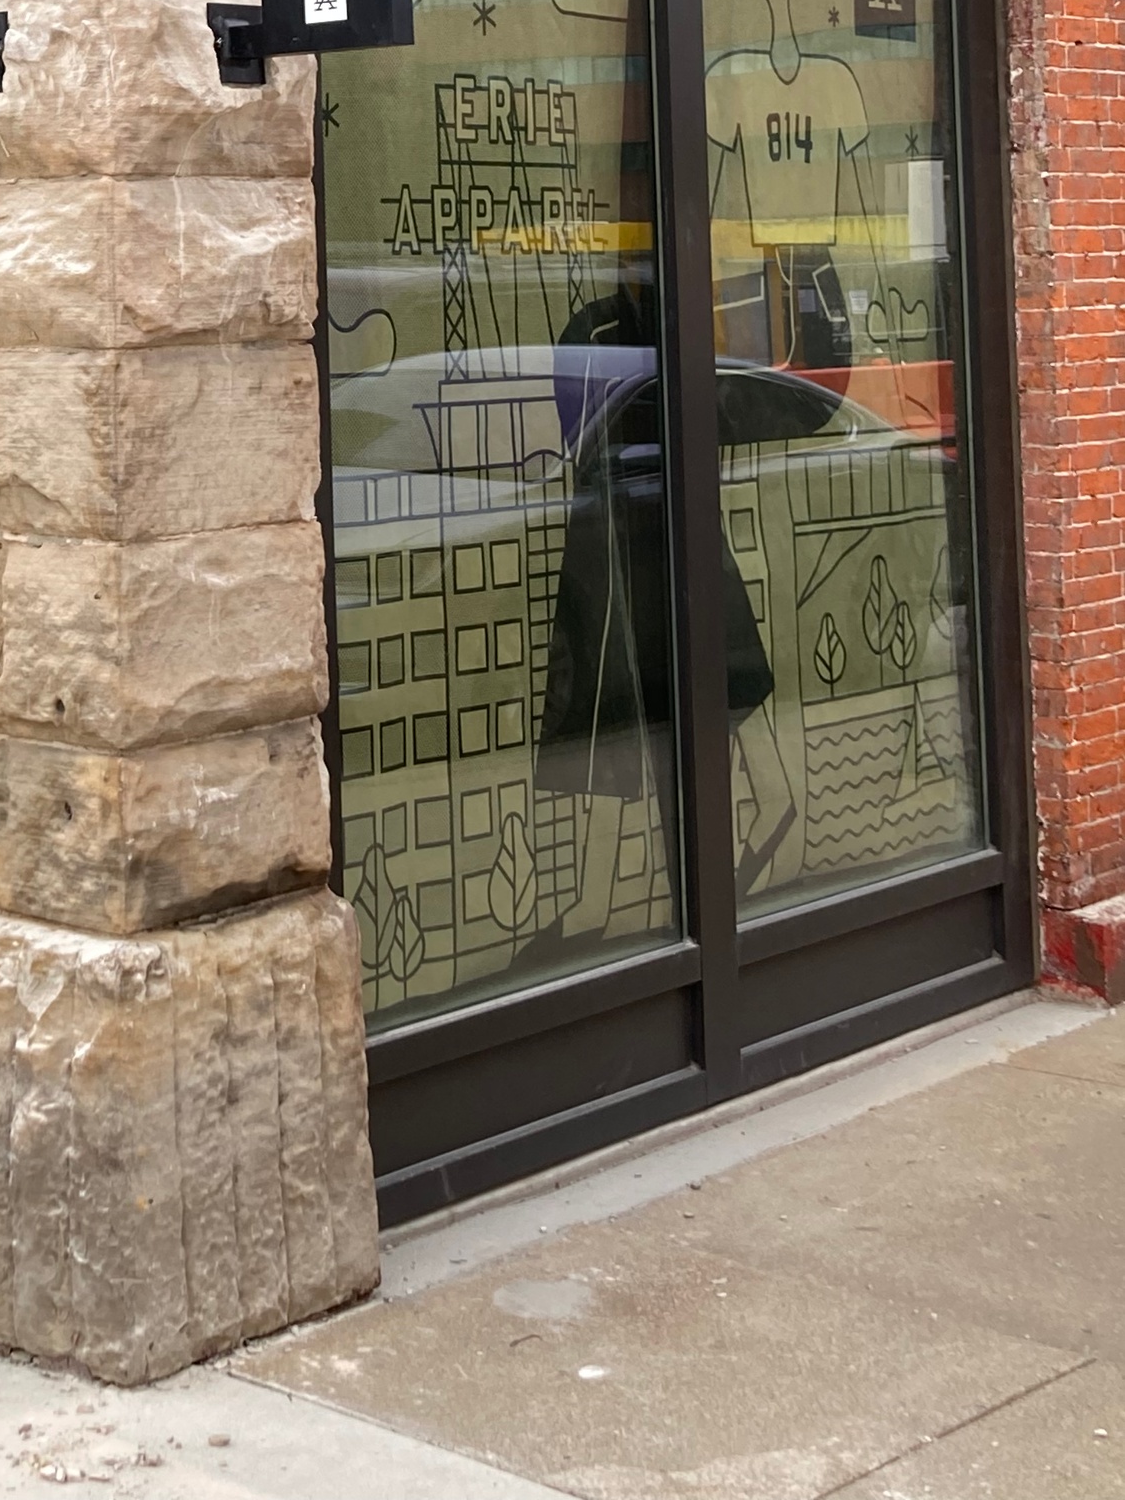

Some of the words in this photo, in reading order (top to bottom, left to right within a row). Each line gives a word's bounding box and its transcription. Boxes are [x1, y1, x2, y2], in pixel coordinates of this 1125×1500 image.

[453, 73, 567, 146] ERIE
[766, 111, 813, 163] 814
[392, 184, 605, 255] APPAREL
